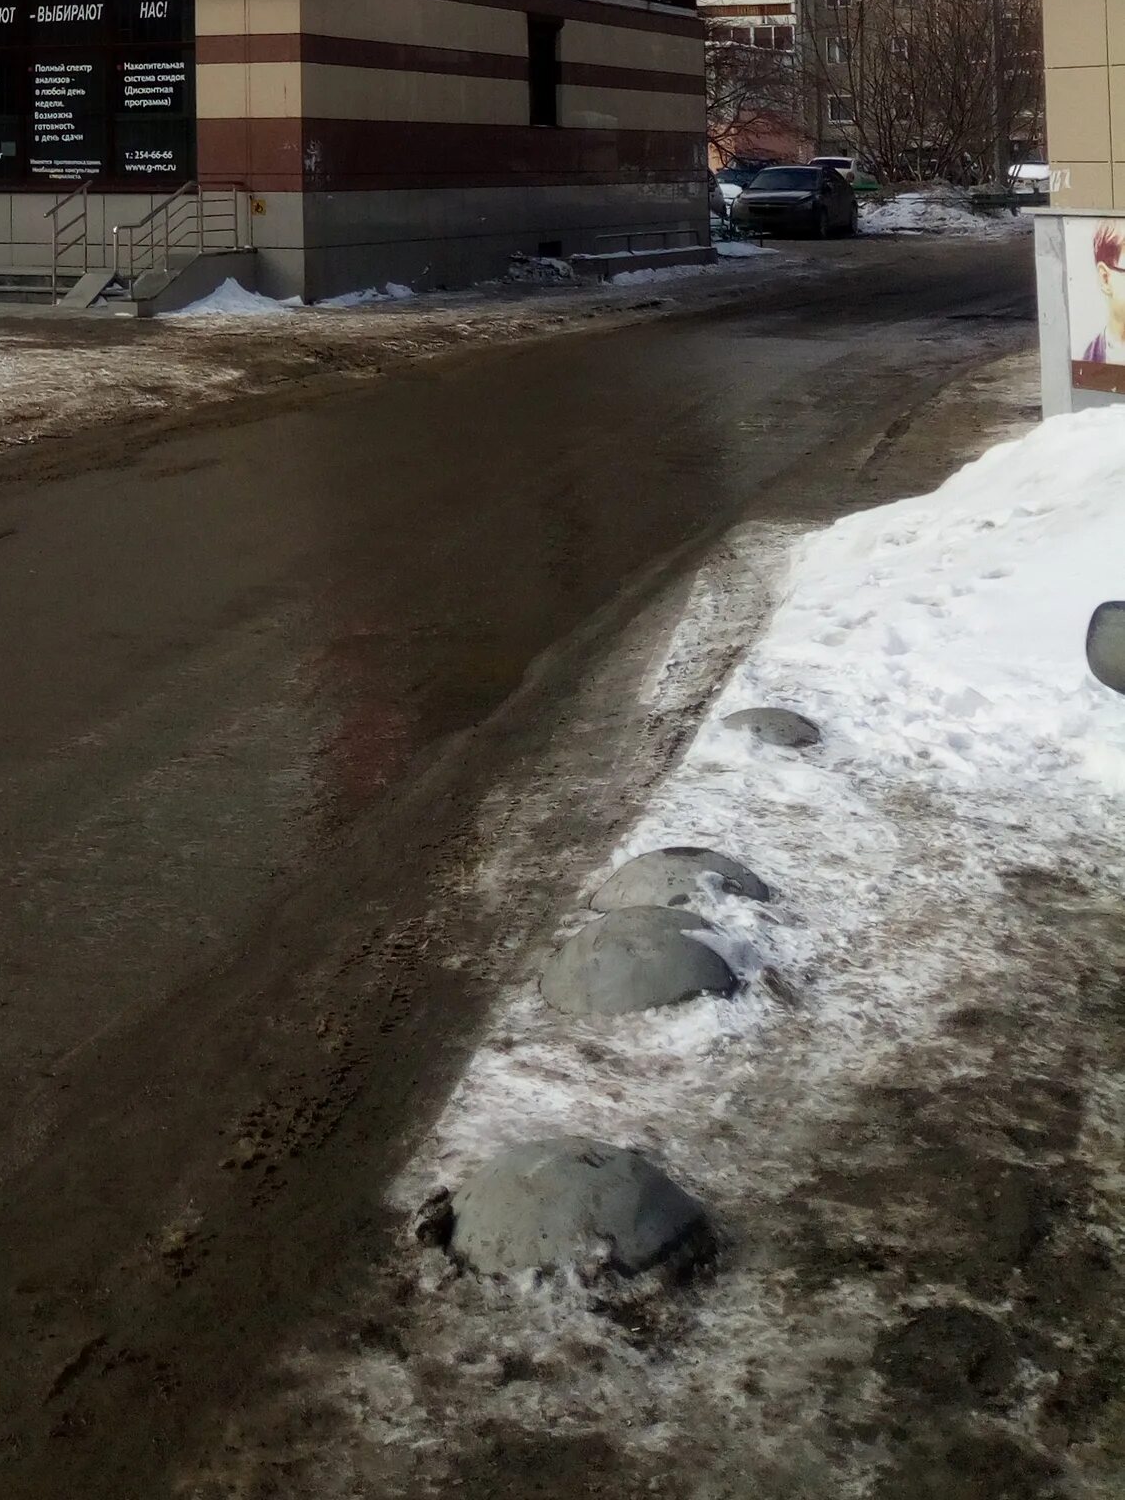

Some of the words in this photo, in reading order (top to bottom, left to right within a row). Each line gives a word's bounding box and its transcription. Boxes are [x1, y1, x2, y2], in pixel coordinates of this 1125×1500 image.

[139, 1, 168, 19] НАС!
[35, 63, 65, 73] Полный
[66, 64, 93, 73] спектр
[124, 62, 185, 71] Накопительная
[124, 74, 155, 83] система
[157, 73, 186, 82] скидок
[40, 86, 66, 96] любой
[66, 88, 86, 97] день
[124, 85, 174, 96] (Дисконтная
[124, 96, 171, 108] программа)
[34, 111, 73, 120] Возможна
[34, 123, 75, 131] готовность
[40, 134, 60, 143] день
[61, 133, 84, 142] сдачи
[134, 150, 173, 160] 254-66-66
[124, 163, 177, 173] www.g-mc.ru
